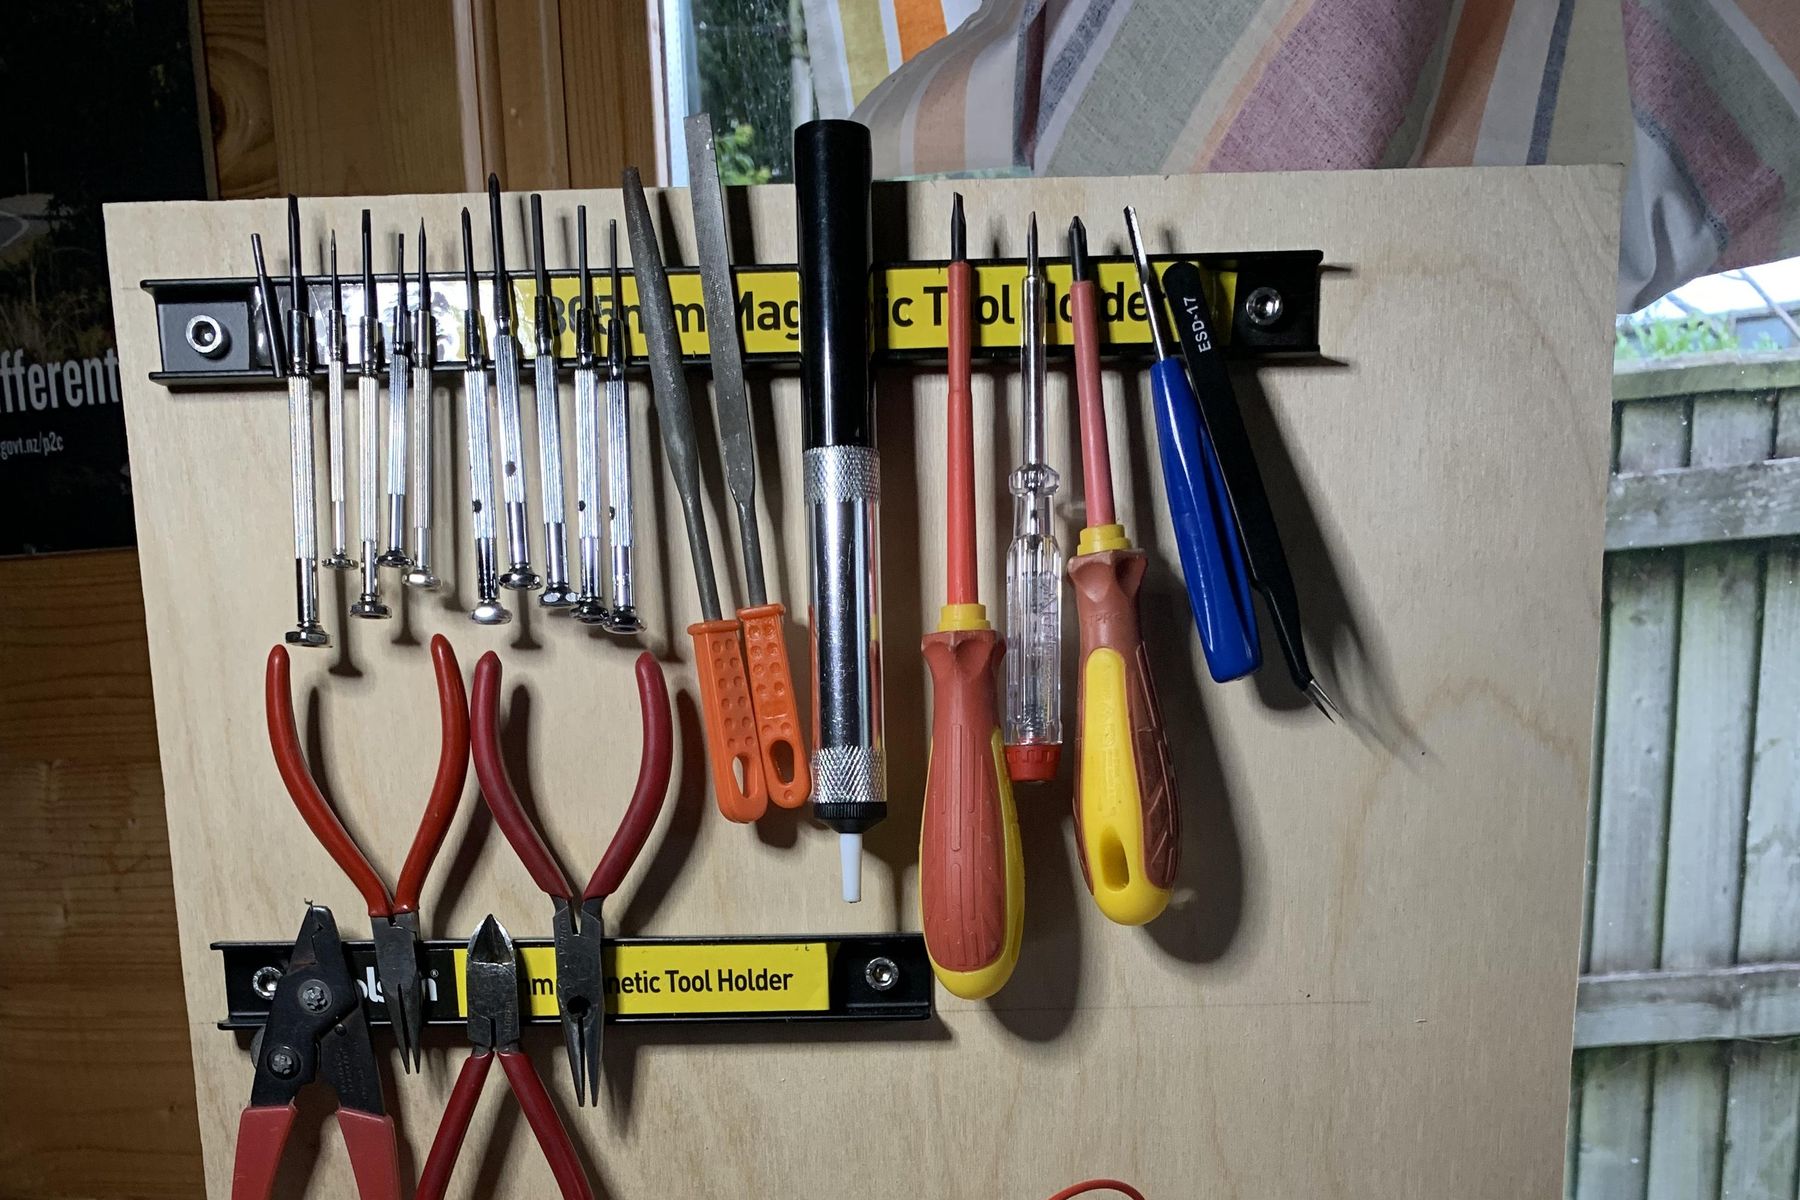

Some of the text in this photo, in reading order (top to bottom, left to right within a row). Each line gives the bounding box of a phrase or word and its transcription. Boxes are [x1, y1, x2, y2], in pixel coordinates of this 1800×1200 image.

[923, 283, 1015, 327] Tol
[1183, 297, 1212, 353] ESD-17
[0, 347, 119, 412] fferent
[664, 969, 713, 993] Tool
[717, 967, 794, 992] Holder
